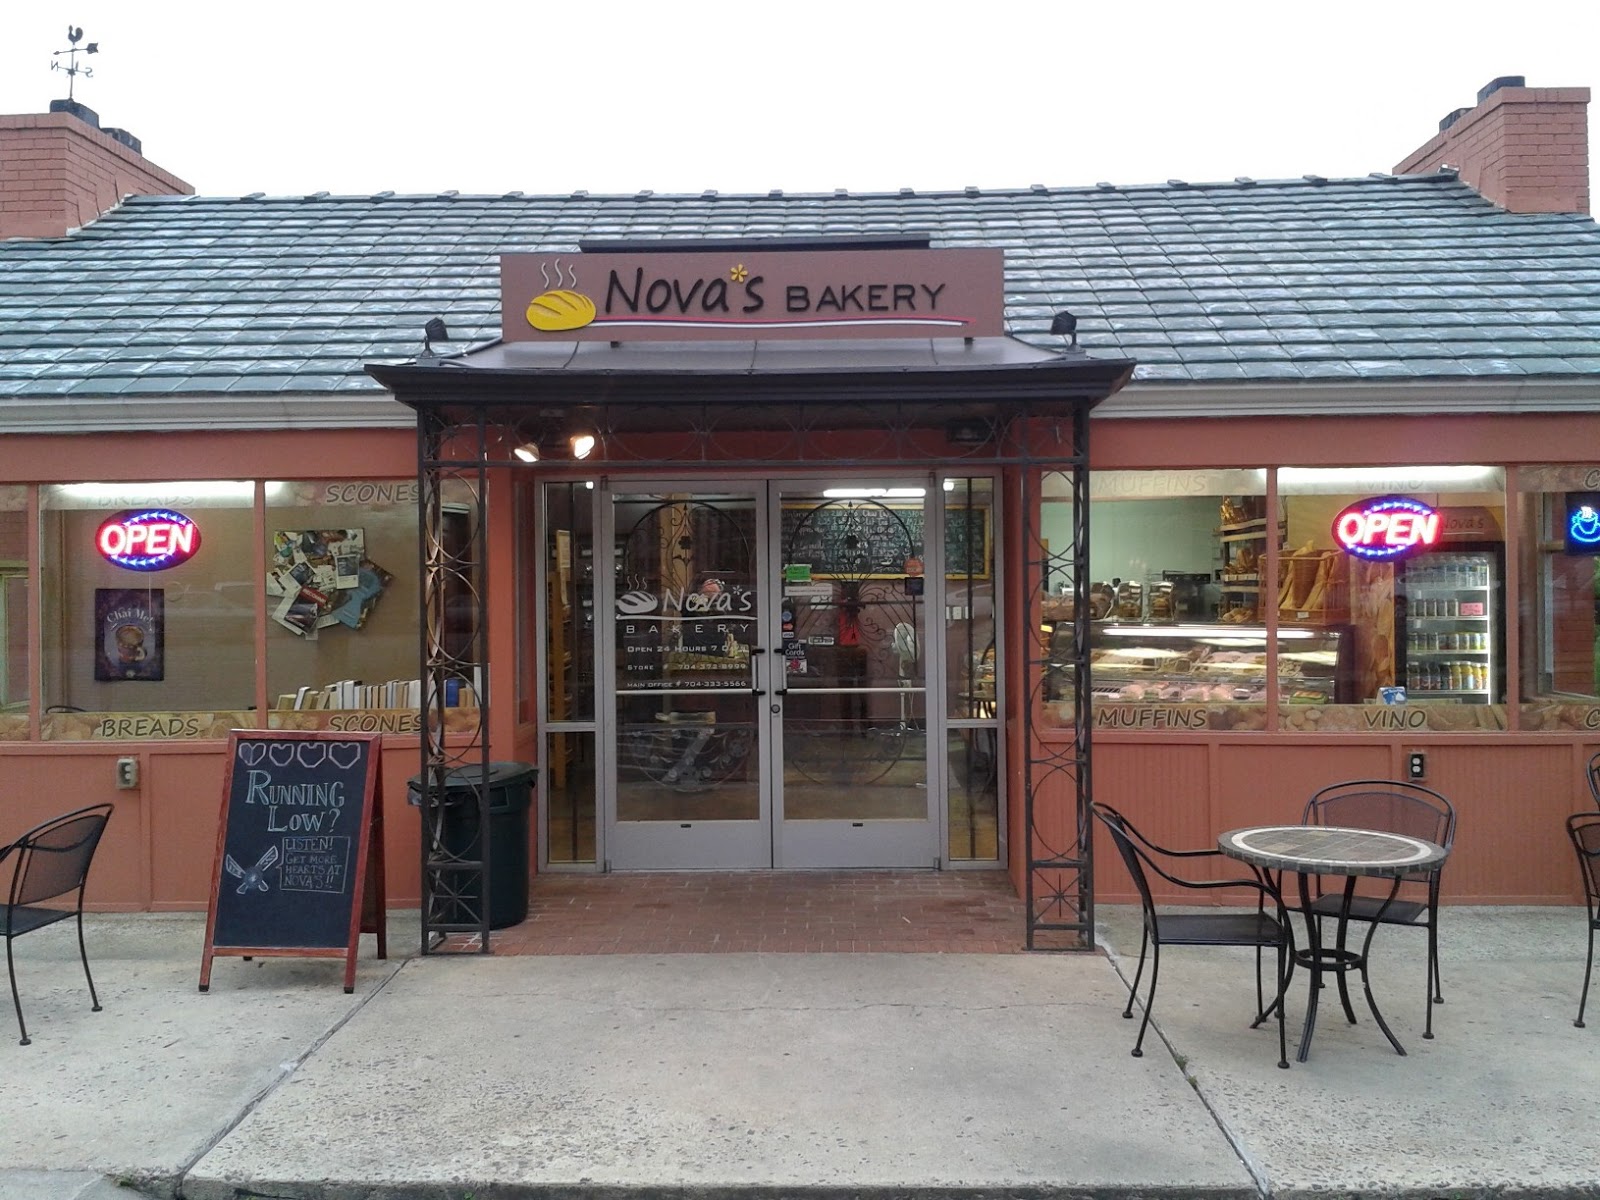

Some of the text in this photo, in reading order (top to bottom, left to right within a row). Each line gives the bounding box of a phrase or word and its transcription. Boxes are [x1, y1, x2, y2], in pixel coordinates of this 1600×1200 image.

[604, 263, 945, 313] Nova's BAKERY
[1098, 474, 1207, 493] MUFFINS
[326, 484, 419, 503] SCONES
[1338, 512, 1438, 546] OPEN
[100, 523, 193, 555] OPEN
[107, 607, 131, 623] Chai
[626, 625, 749, 633] BAKERY
[101, 716, 200, 737] BREADS
[328, 713, 421, 732] SCONES
[1098, 709, 1207, 728] MUFFINS
[1364, 709, 1427, 728] VINO
[245, 770, 345, 807] RUNNING
[285, 837, 334, 851] LISTEN!
[309, 855, 337, 865] MORE
[285, 865, 343, 876] HEARTS AT
